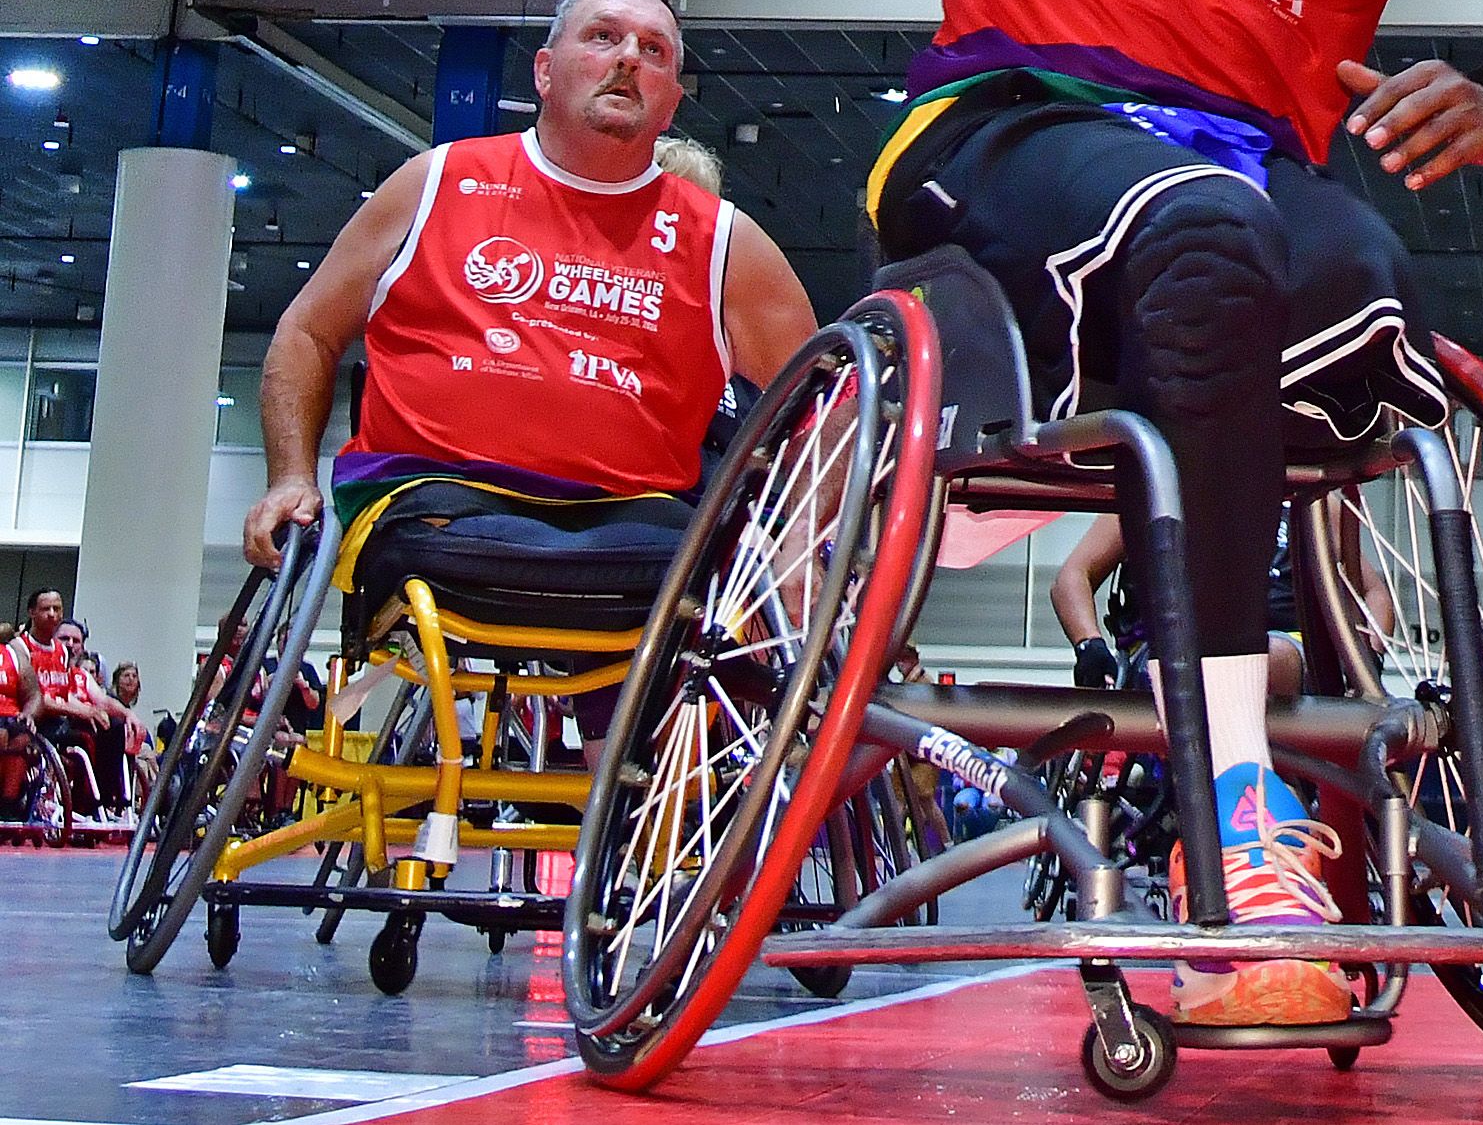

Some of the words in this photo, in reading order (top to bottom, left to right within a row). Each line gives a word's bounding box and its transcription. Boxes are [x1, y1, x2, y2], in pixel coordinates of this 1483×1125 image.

[650, 210, 680, 253] 5
[548, 274, 662, 321] GAMES
[554, 261, 665, 297] WHEELCHAIR
[451, 355, 473, 371] VA
[587, 353, 643, 397] PVA
